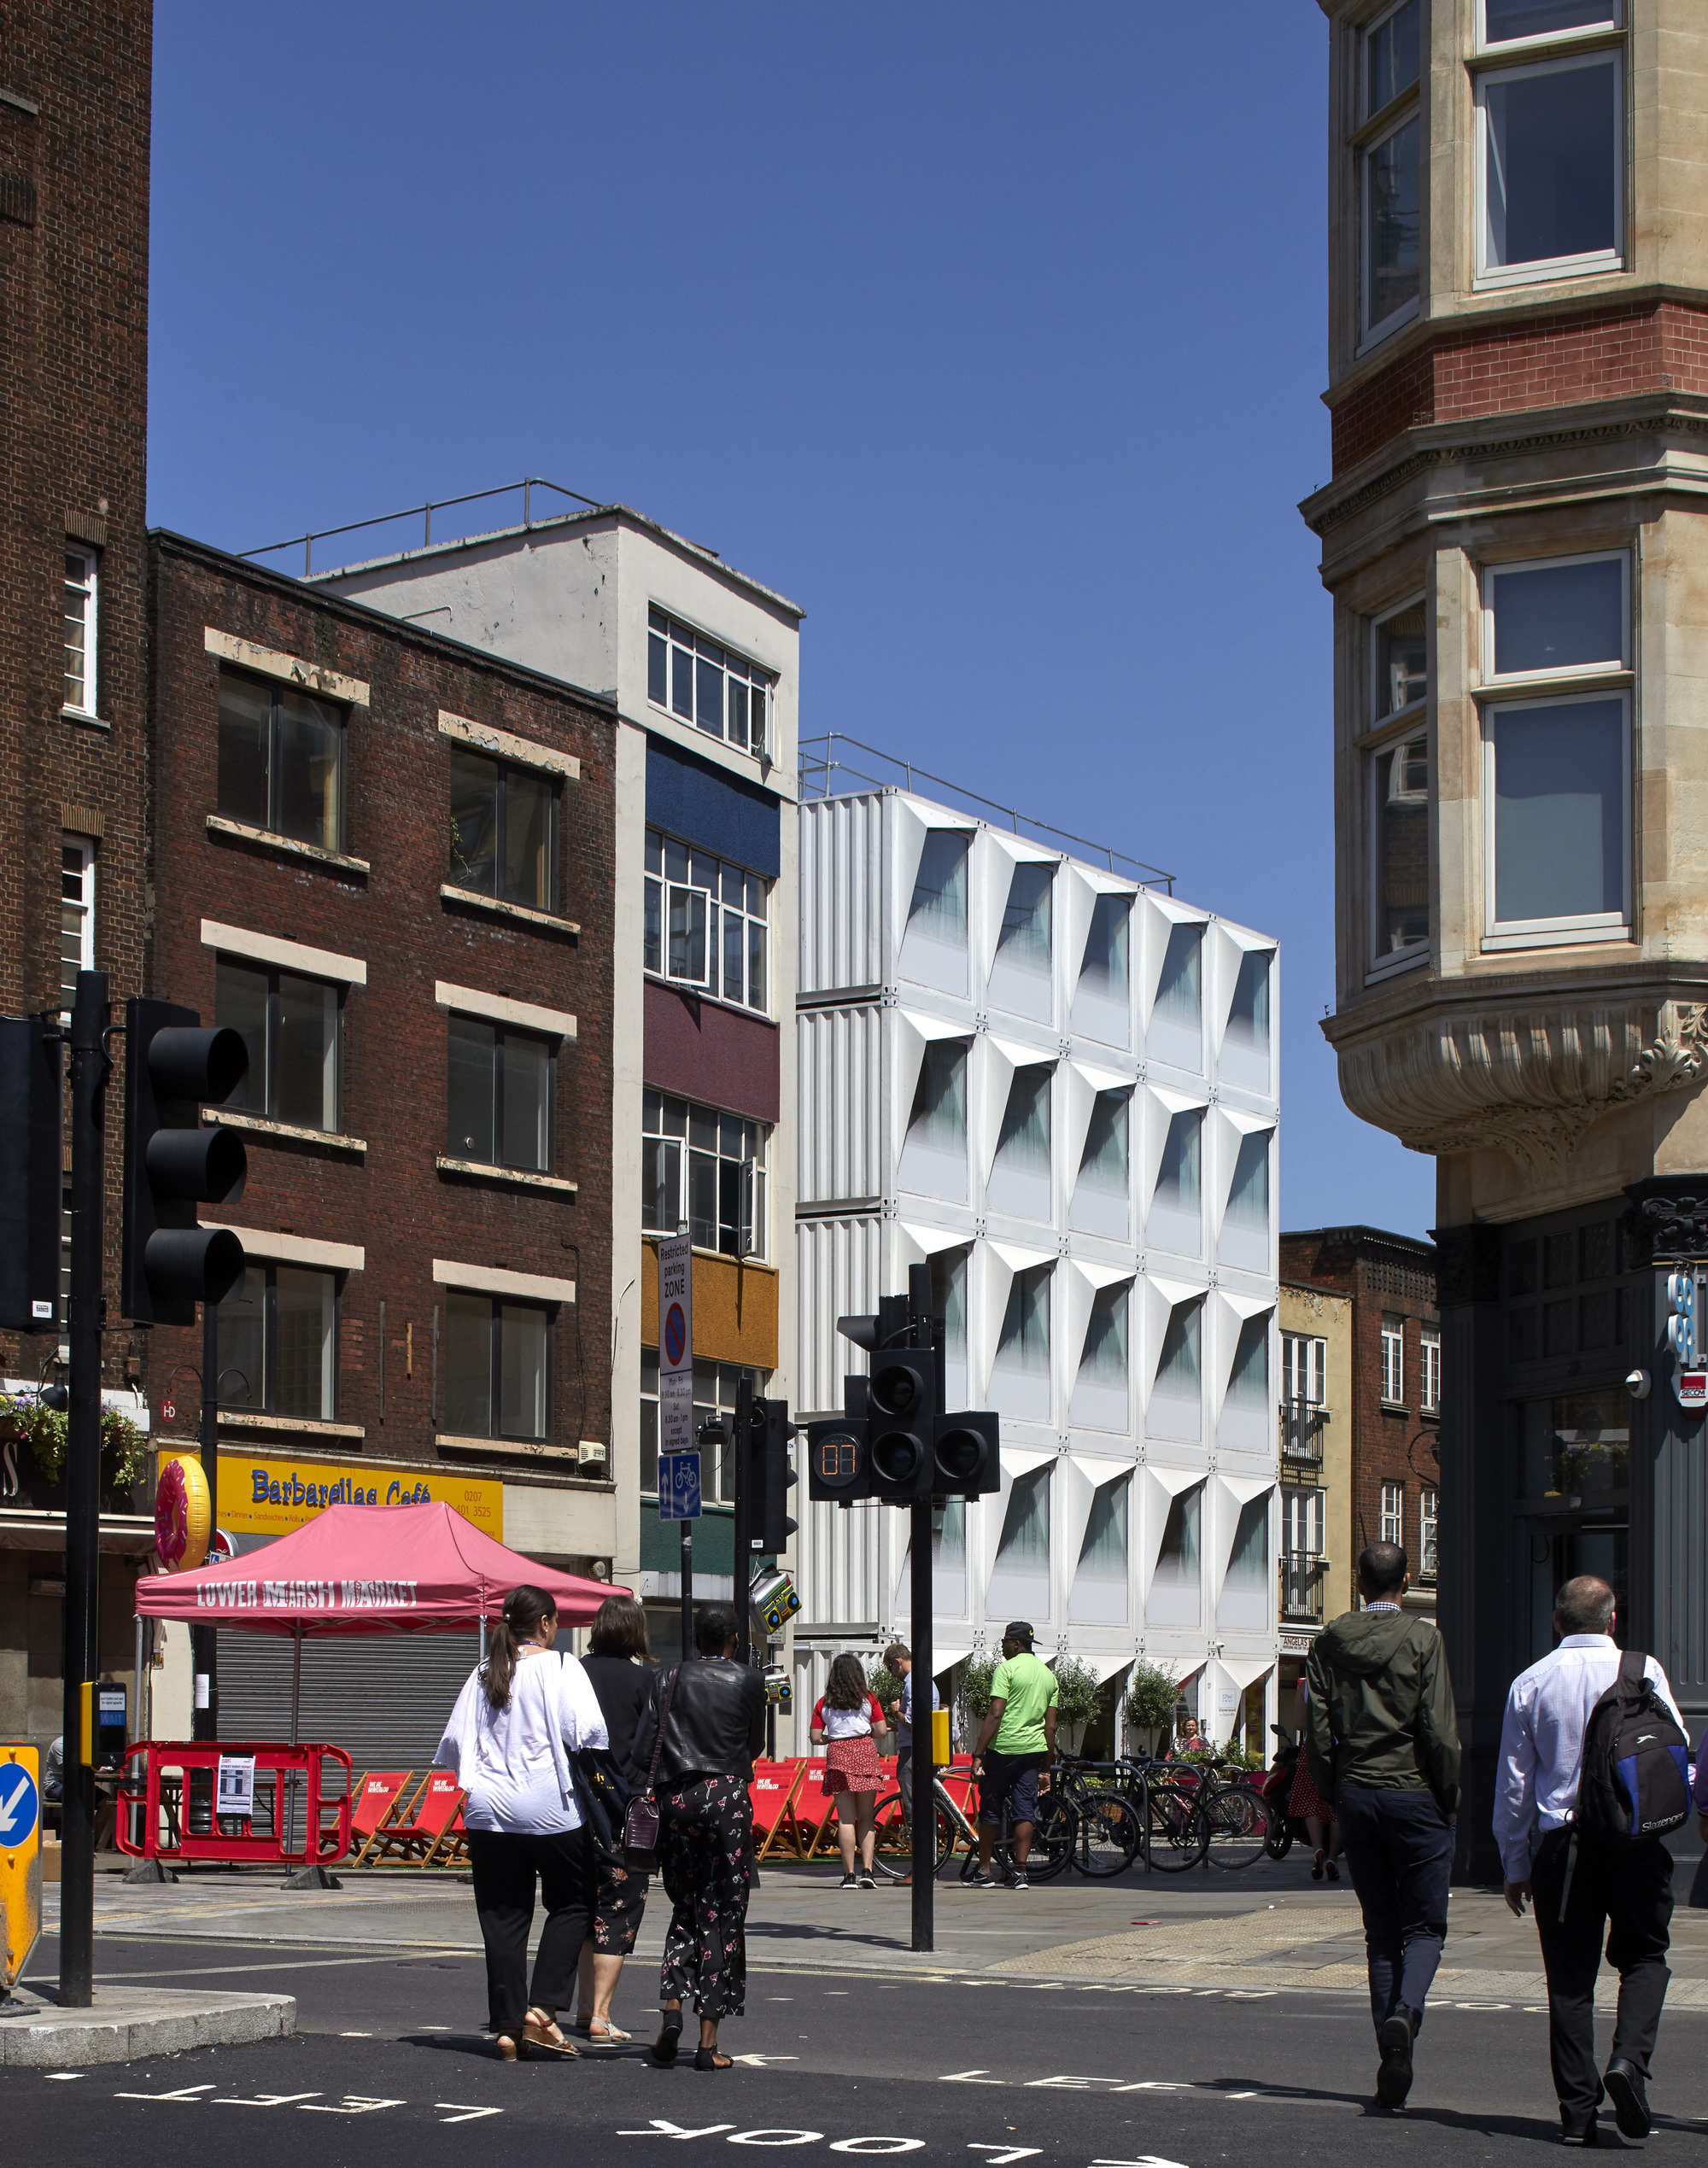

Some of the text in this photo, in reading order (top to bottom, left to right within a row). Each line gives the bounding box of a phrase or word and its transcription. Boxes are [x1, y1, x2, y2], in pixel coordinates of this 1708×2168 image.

[660, 1242, 688, 1261] Restricted
[664, 1262, 685, 1279] parking
[664, 1278, 685, 1299] ZONE
[671, 1426, 682, 1435] except
[822, 1445, 855, 1475] 07
[251, 1469, 431, 1506] Barbarellas Café
[465, 1491, 483, 1502] 0207
[231, 1511, 249, 1519] Dinner
[254, 1512, 284, 1522] Sandwiches
[456, 1505, 491, 1517] 401 3525
[196, 1580, 418, 1608] LOWER MARSH MARKET
[101, 1713, 123, 1724] WAIT
[1642, 1812, 1684, 1832] Slazenger
[939, 2070, 1307, 2099] LEFT
[114, 2084, 1044, 2164] LOOK LEFT
